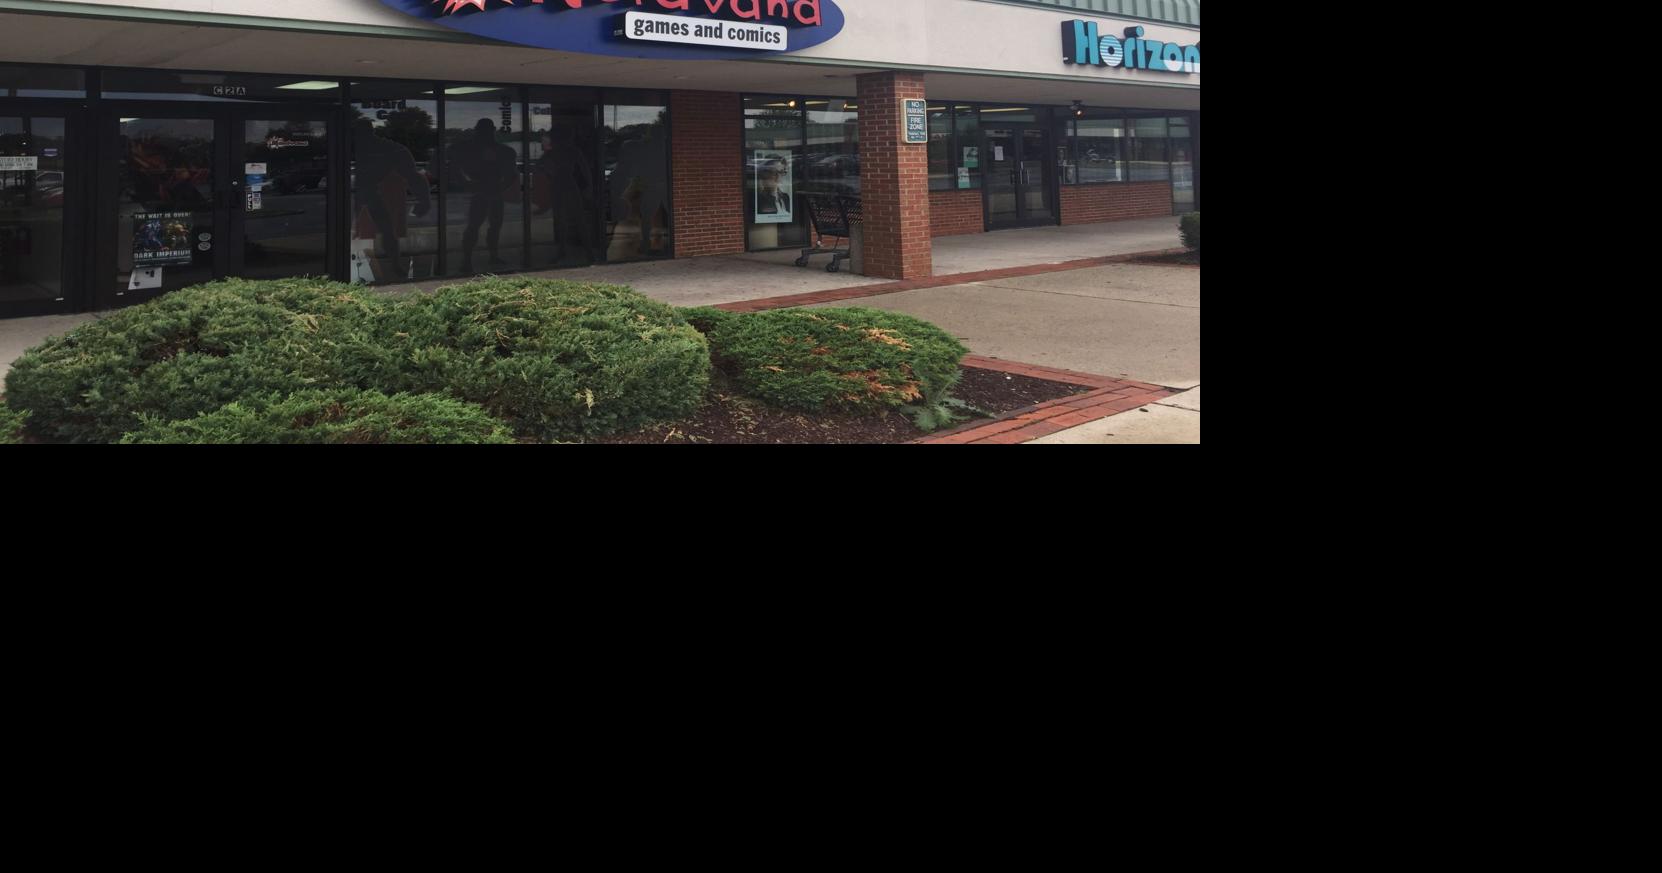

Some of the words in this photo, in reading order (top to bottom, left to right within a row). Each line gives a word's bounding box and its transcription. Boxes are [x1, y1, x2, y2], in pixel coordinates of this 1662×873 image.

[633, 18, 690, 37] games
[694, 22, 723, 40] and
[727, 27, 781, 44] comics
[1070, 19, 1200, 73] Horizon
[133, 251, 153, 259] DARK
